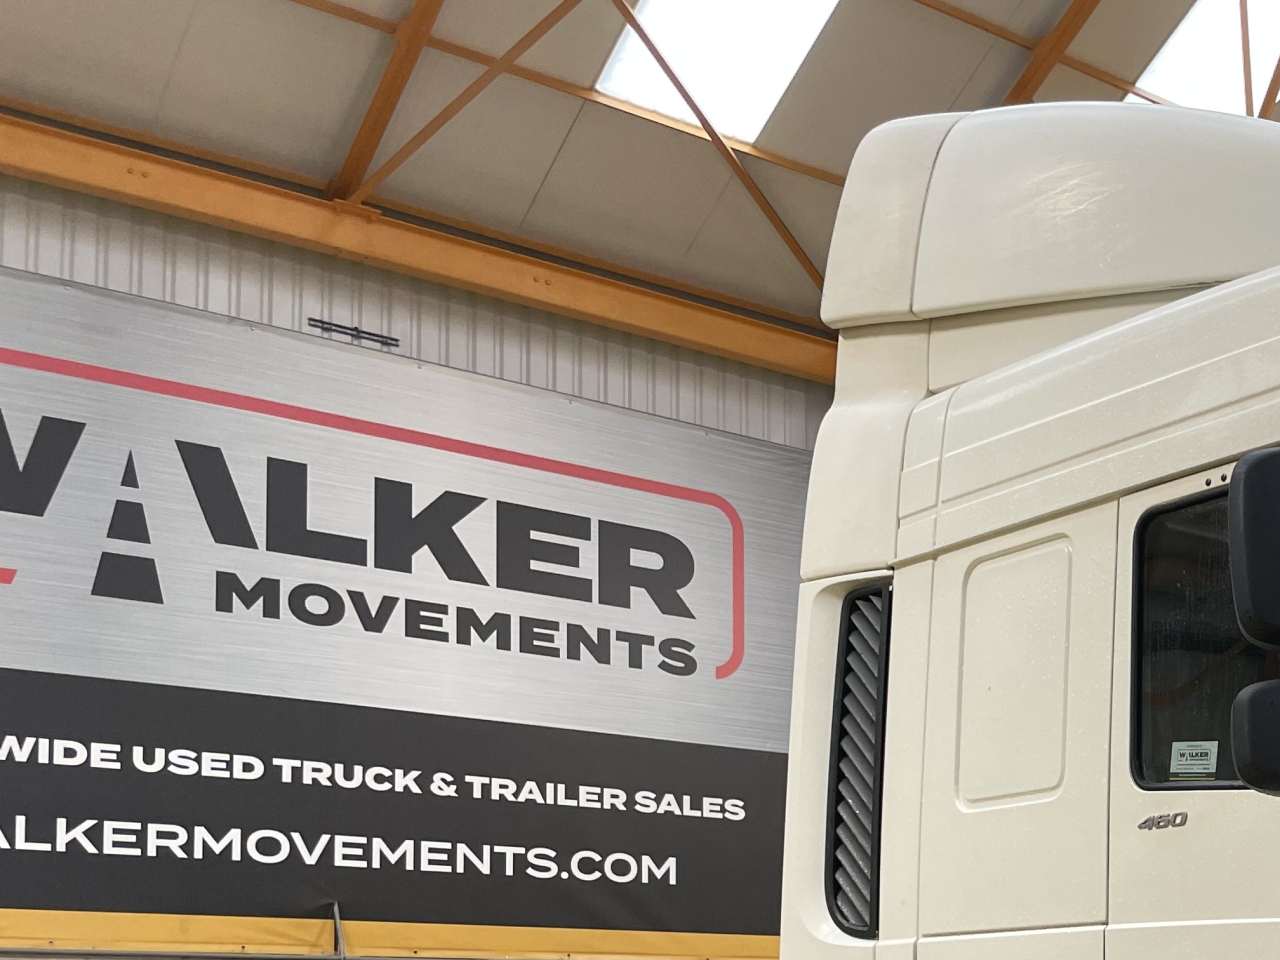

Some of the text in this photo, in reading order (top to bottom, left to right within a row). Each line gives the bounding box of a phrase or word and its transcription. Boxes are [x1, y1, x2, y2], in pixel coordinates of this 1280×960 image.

[214, 569, 699, 677] MOVEMENTS
[132, 745, 265, 780] USED
[272, 757, 423, 795] TRUCK
[430, 771, 459, 798] &
[464, 774, 628, 811] TRAILER
[634, 790, 747, 822] SALES
[0, 814, 677, 886] LKERMOVEMENTS.COM
[1137, 811, 1188, 831] 460
